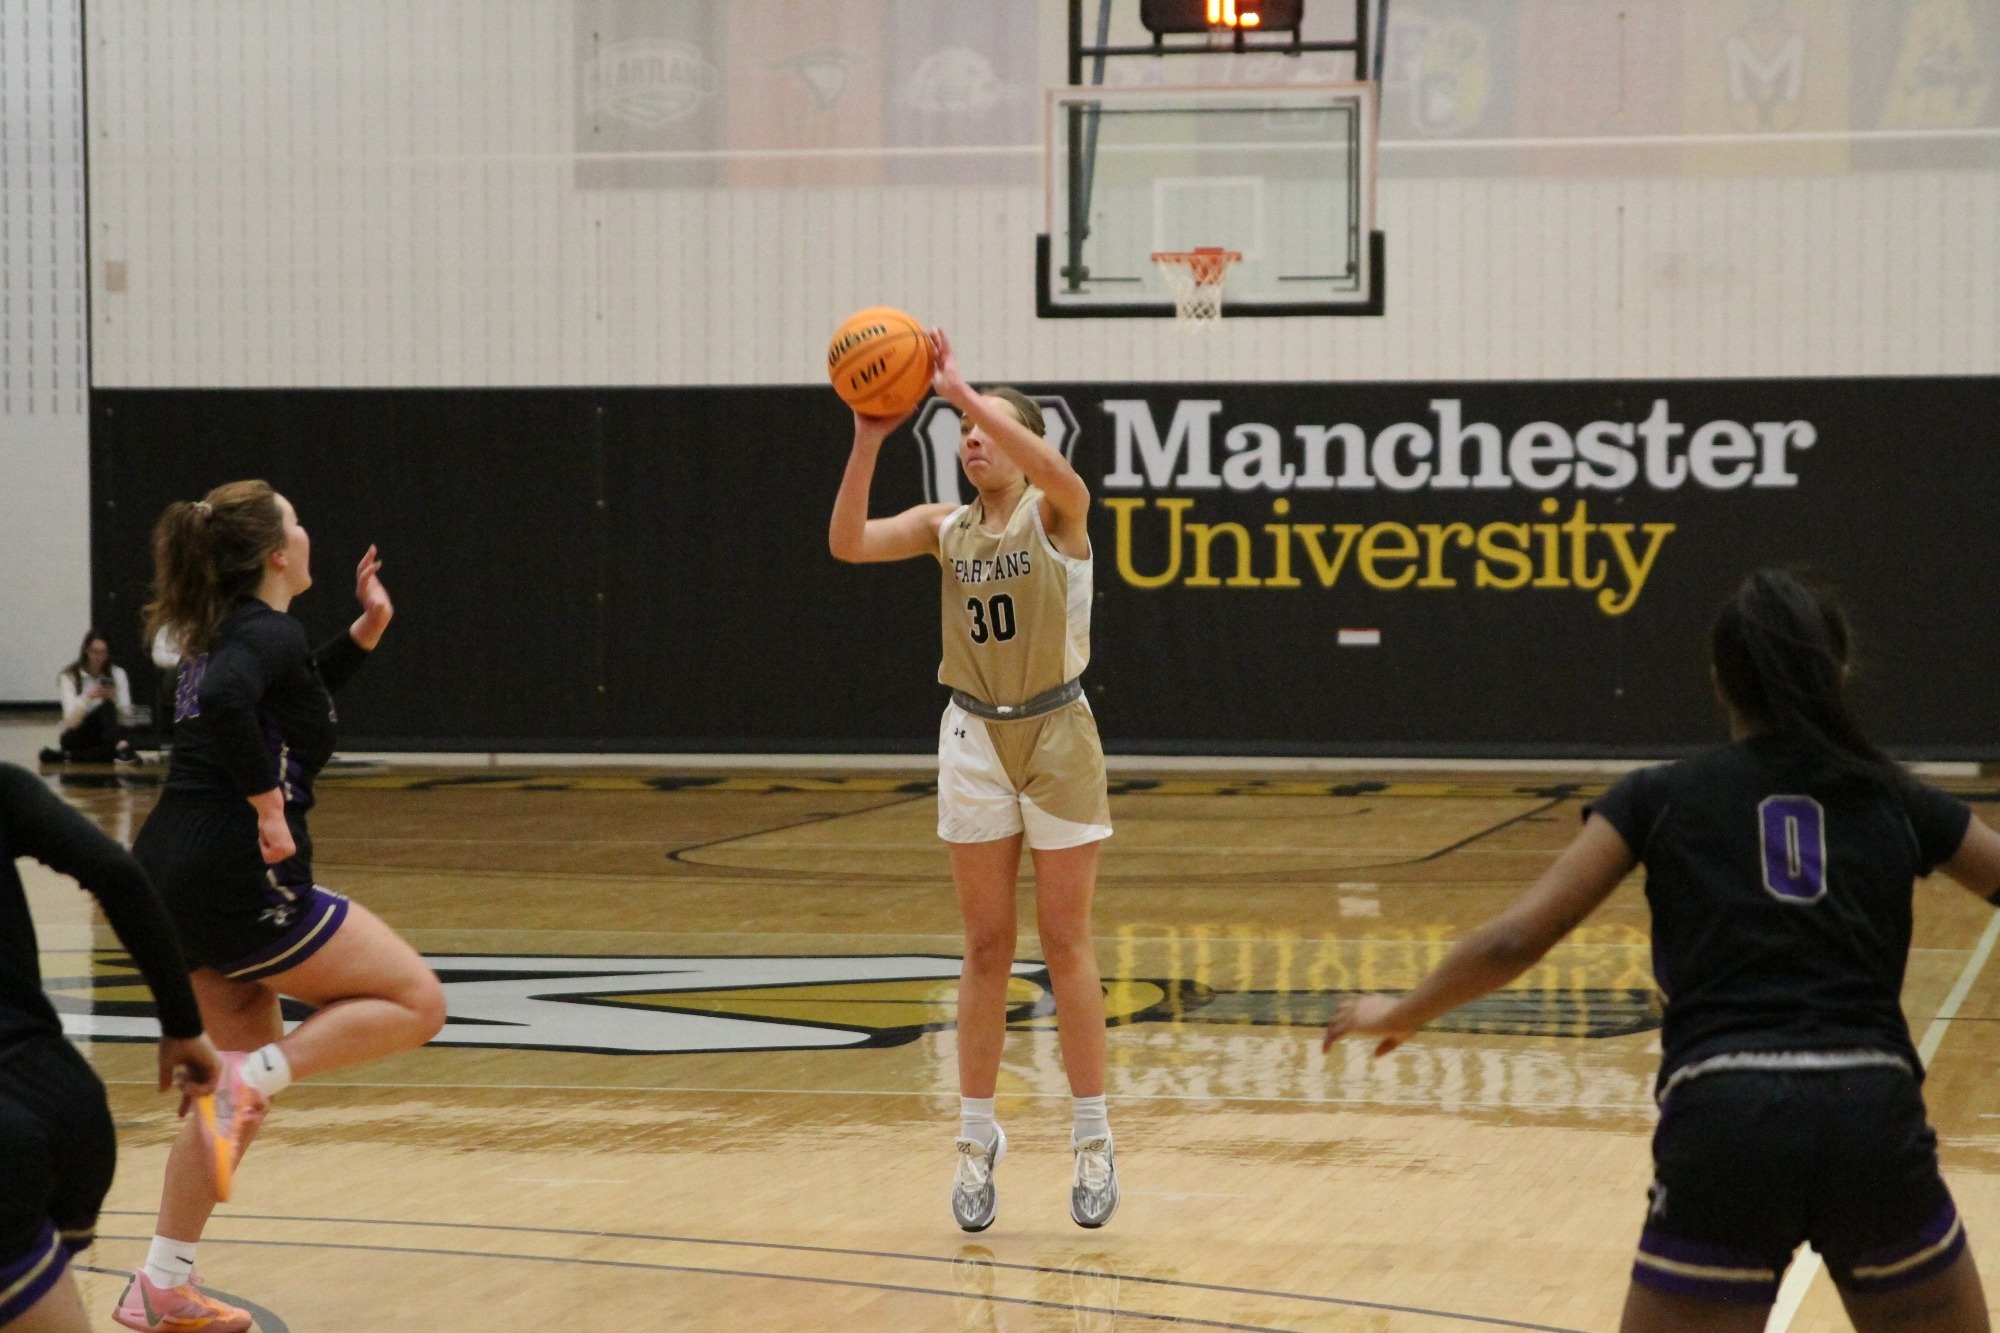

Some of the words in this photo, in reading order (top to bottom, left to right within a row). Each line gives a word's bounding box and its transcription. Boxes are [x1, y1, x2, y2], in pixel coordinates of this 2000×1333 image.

[1102, 399, 1818, 491] Manchester
[950, 551, 1031, 583] PARTANS
[1104, 498, 1676, 615] University
[966, 593, 1017, 645] 30
[1757, 794, 1828, 906] 0
